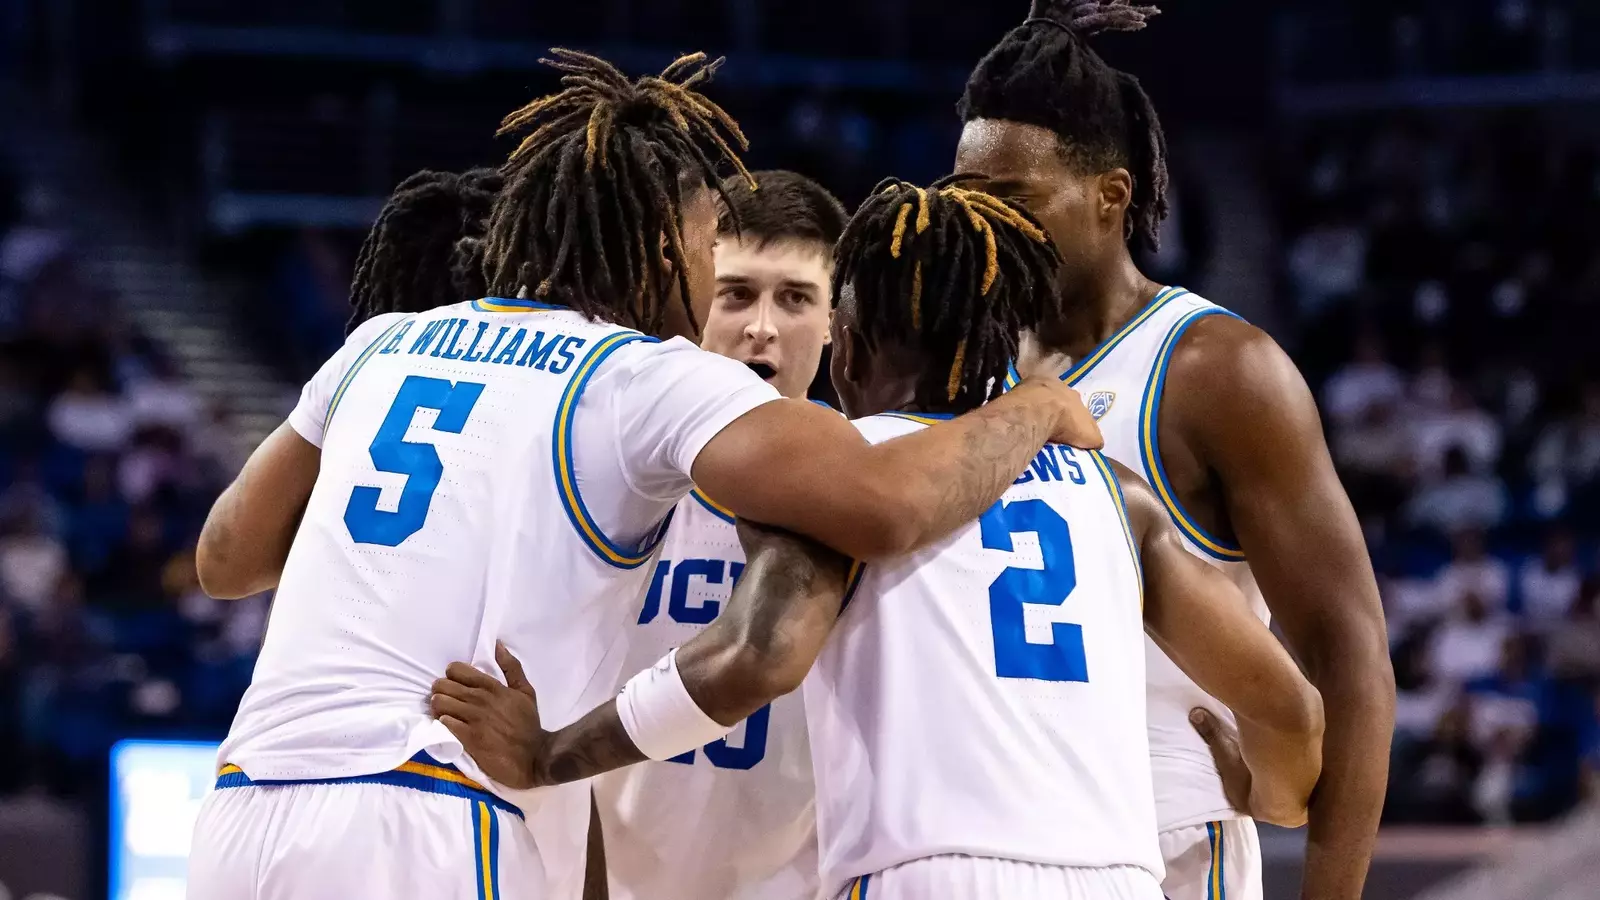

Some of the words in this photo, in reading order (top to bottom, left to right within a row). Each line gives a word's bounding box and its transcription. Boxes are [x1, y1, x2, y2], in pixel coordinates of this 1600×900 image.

[379, 319, 416, 354] B.
[407, 317, 587, 375] WILLIAMS
[1089, 391, 1114, 412] PAC
[343, 375, 486, 547] 5
[979, 498, 1090, 683] 2
